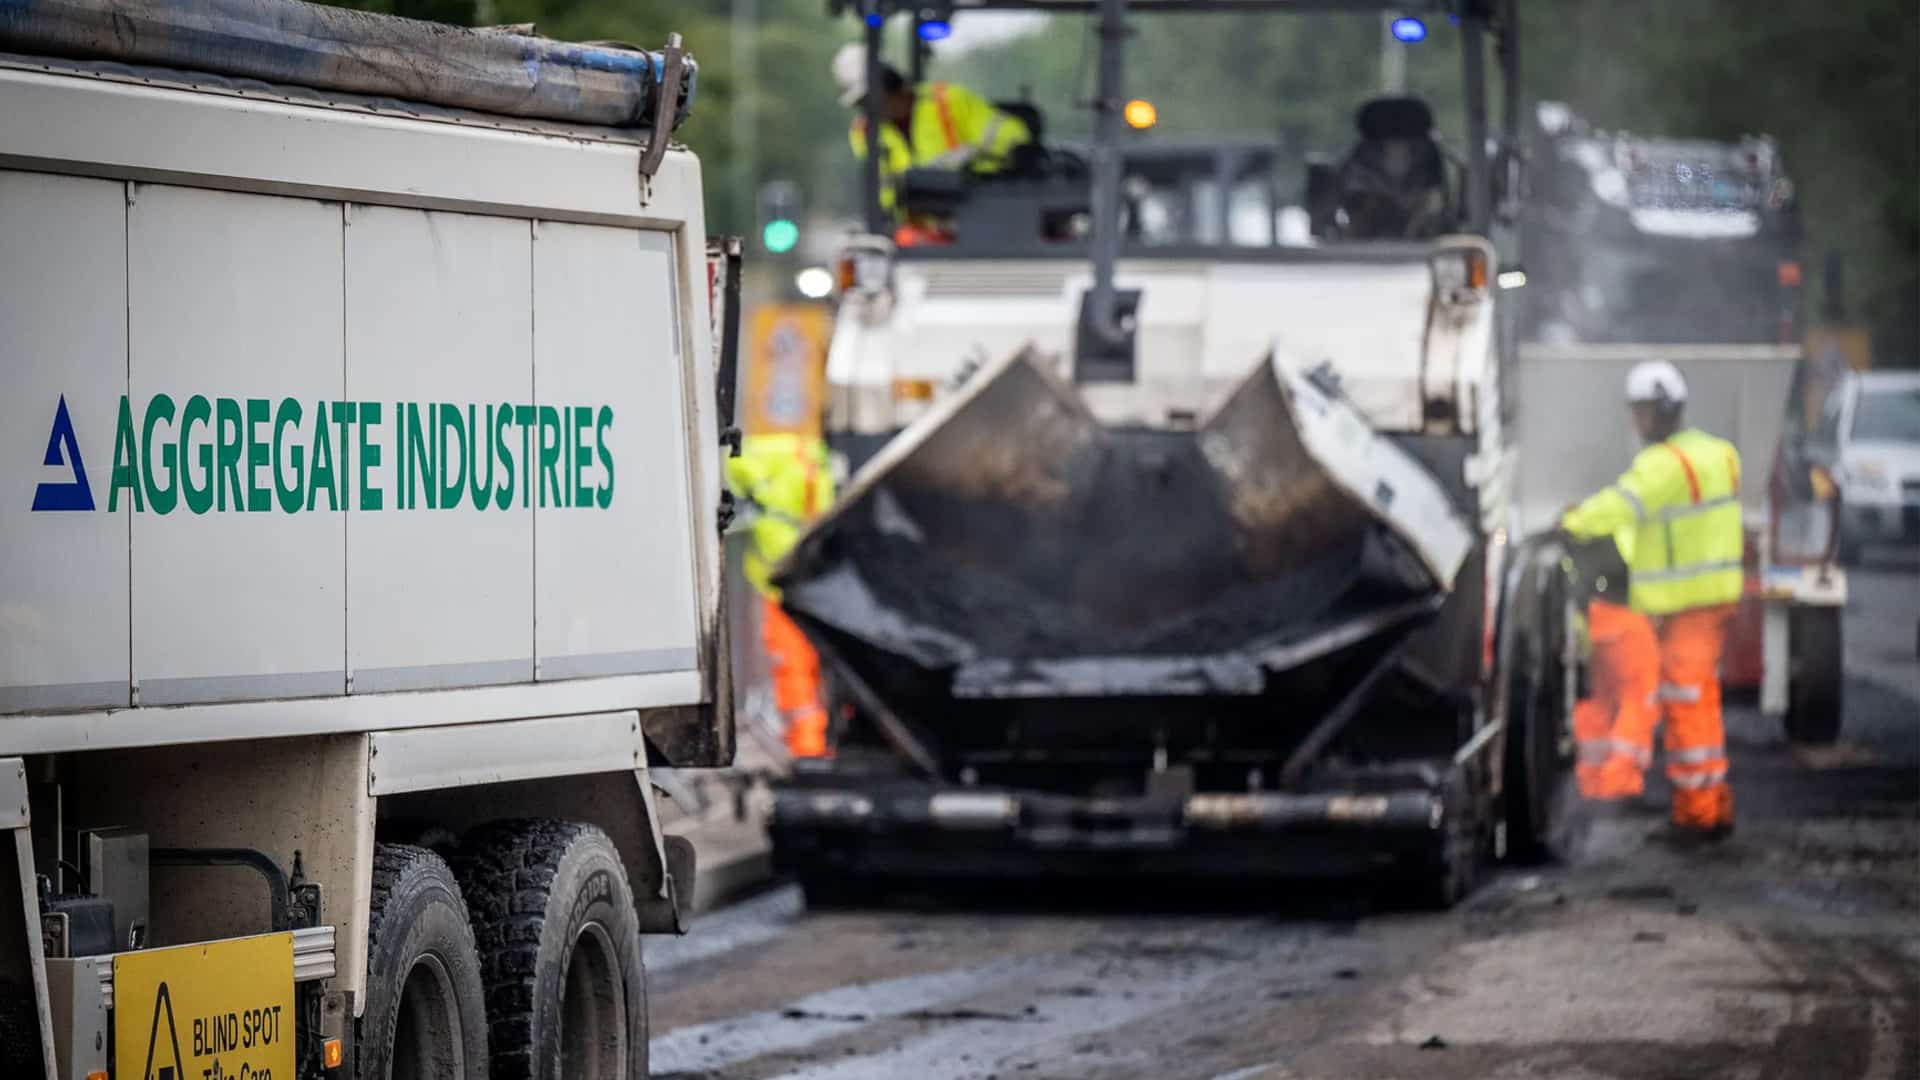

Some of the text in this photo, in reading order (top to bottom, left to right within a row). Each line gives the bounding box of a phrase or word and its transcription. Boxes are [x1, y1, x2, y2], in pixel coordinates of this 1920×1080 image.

[108, 394, 615, 514] AGGREGATE INDUSTRIES
[193, 1004, 281, 1057] BLIND SPOT
